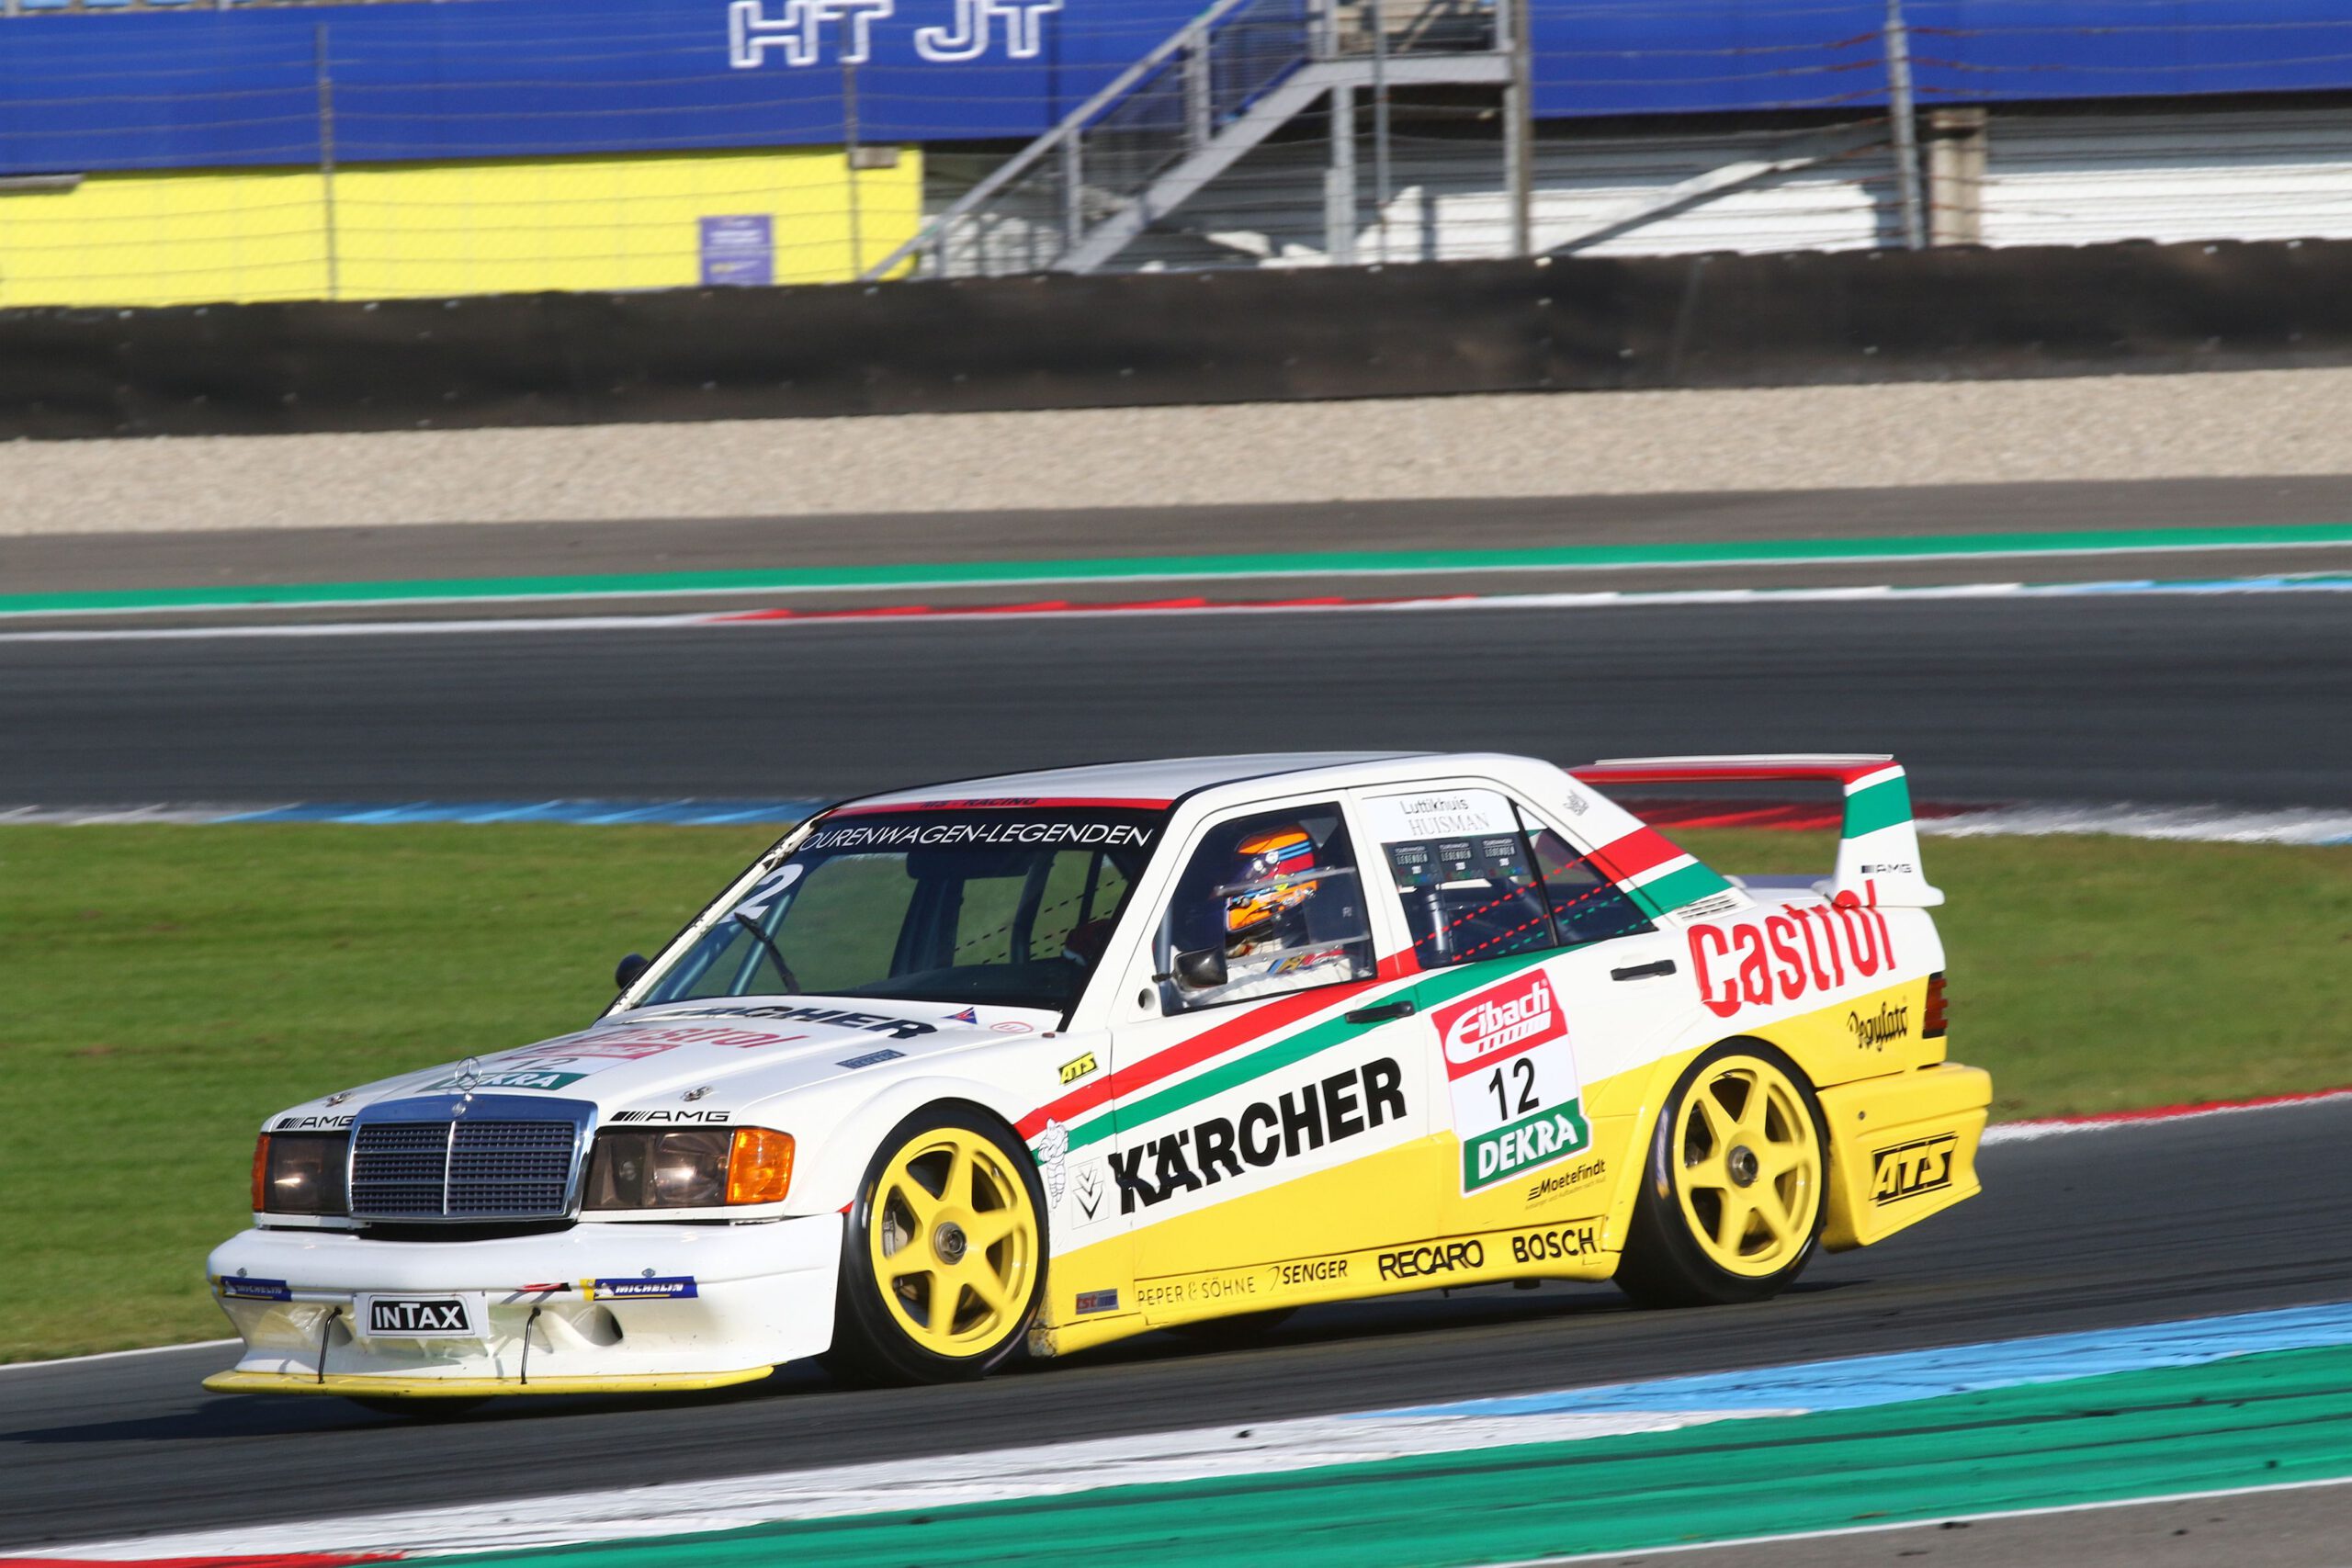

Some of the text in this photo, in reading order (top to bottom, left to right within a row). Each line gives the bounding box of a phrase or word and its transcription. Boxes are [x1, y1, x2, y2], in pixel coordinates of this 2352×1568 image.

[1400, 796, 1469, 815] Luttikhuis
[798, 822, 1154, 852] OURENWAGEN-LEGENDEN
[1408, 812, 1490, 836] HUISMAN
[1875, 863, 1913, 874] AMG
[1687, 878, 1896, 1018] Castrol
[1445, 979, 1553, 1066] Eibach
[506, 1057, 579, 1071] 12
[1060, 1053, 1096, 1084] ATS
[1488, 1057, 1540, 1122] 12
[300, 1115, 356, 1129] AMG
[644, 1111, 729, 1122] AMG
[1108, 1056, 1408, 1215] KÄRCHER
[1477, 1113, 1578, 1180] DEKRA
[1871, 1138, 1958, 1200] ATS
[1378, 1239, 1485, 1281] RECARO
[1512, 1227, 1598, 1264] BOSCH
[1283, 1259, 1349, 1285] SENGER
[237, 1285, 283, 1294] MICHELIN
[616, 1282, 684, 1294] MICHELIN
[1137, 1285, 1183, 1307] PEPER
[1202, 1277, 1255, 1300] SÖHNE
[374, 1303, 463, 1329] INTAX
